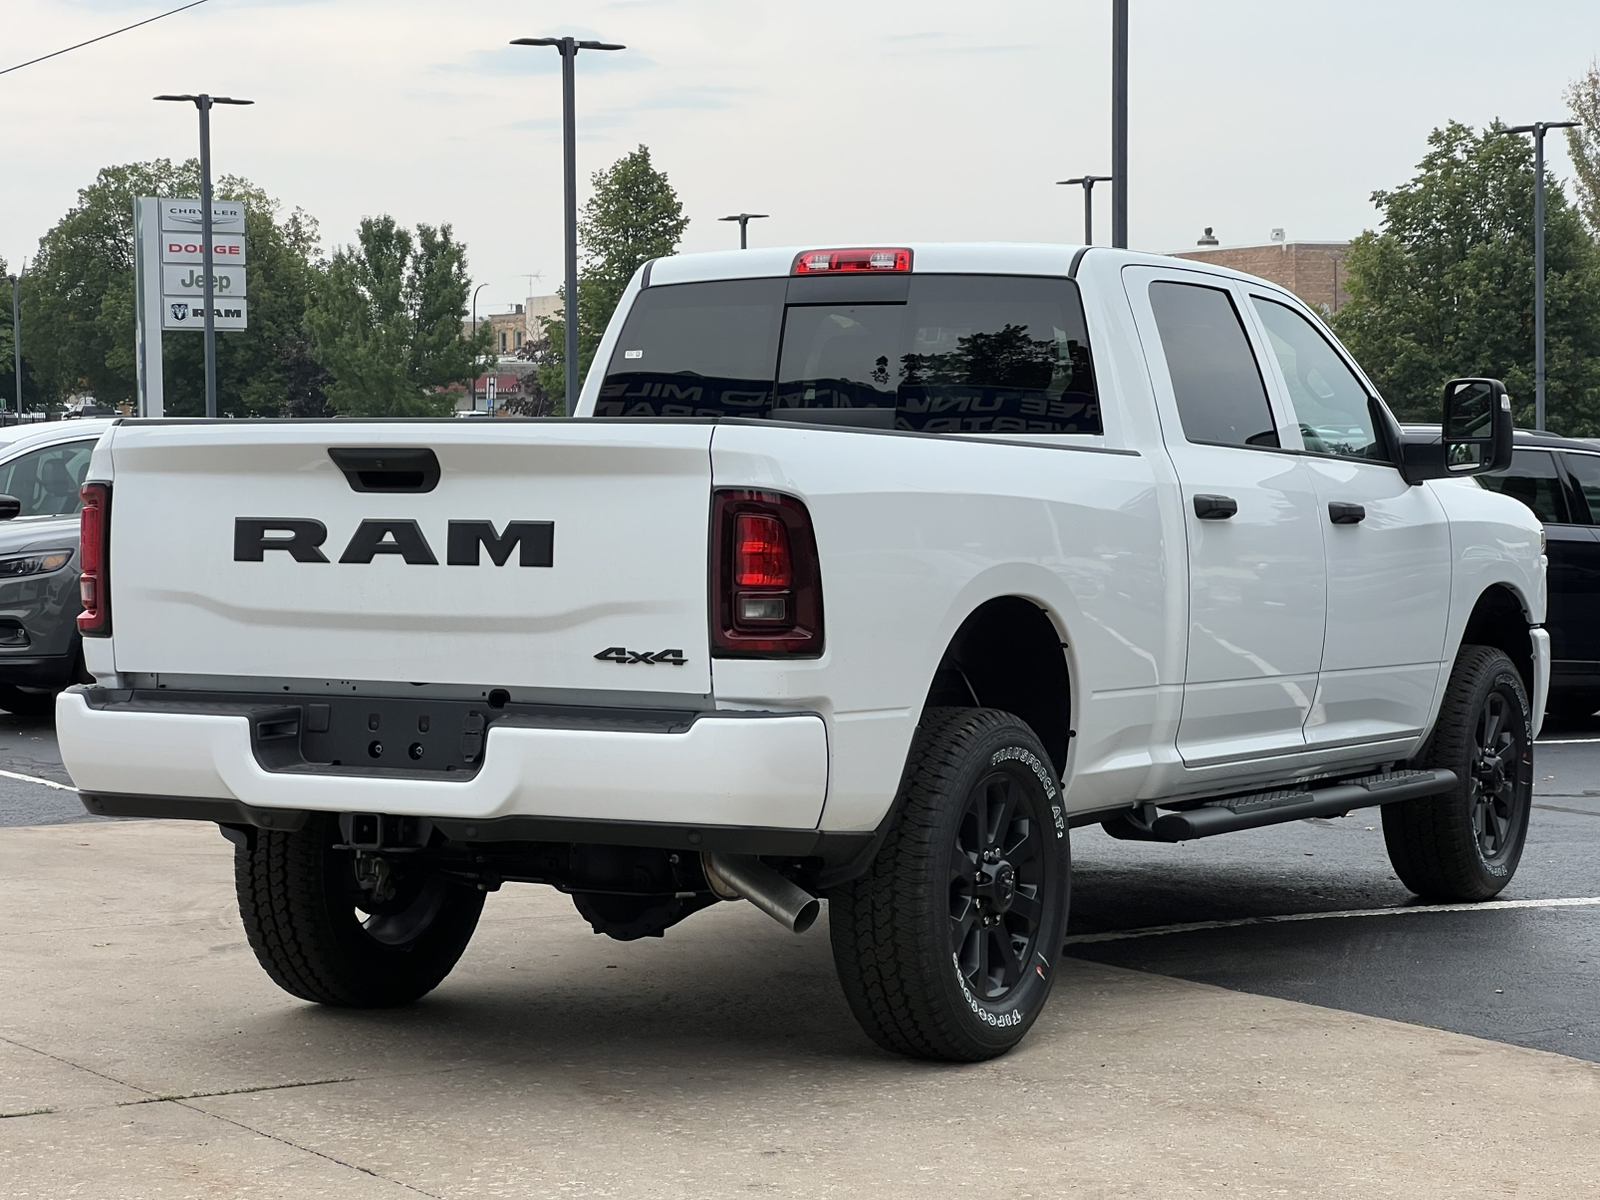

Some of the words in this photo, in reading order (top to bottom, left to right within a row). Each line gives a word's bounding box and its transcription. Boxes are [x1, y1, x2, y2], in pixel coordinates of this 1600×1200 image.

[233, 517, 555, 568] RAM
[593, 647, 688, 666] 4x4
[991, 746, 1057, 800] TRANSFORCE
